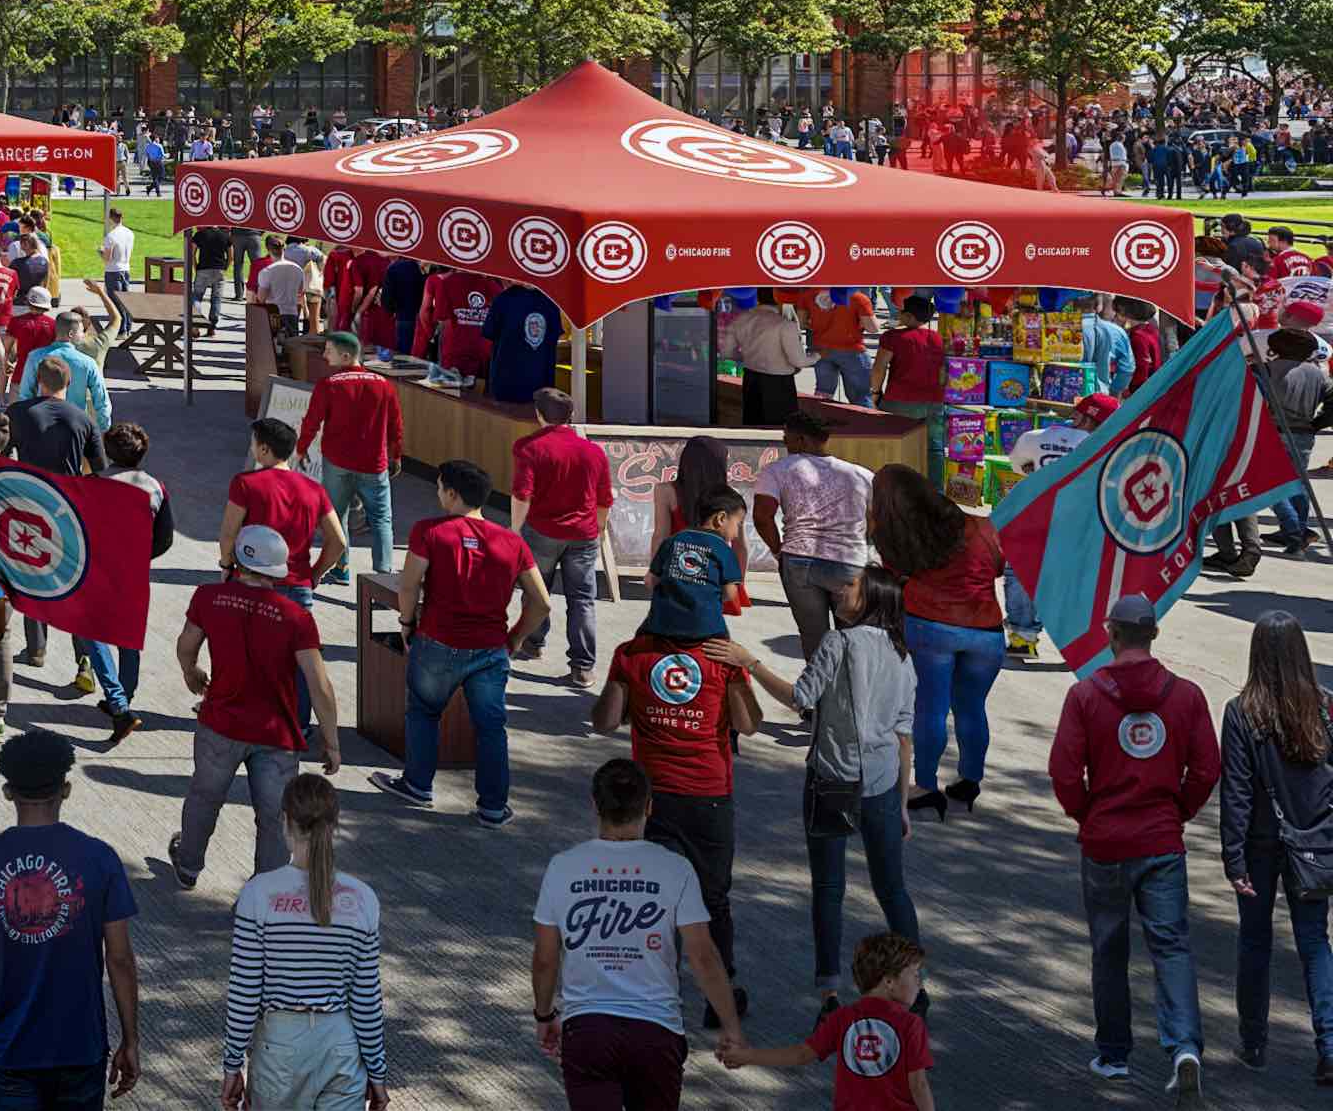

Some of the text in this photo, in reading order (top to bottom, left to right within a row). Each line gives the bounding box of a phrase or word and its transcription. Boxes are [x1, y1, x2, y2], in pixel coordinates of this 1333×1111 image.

[678, 247, 731, 257] CHICAGO FIRE
[862, 247, 916, 257] CHICAGO FIRE
[1037, 247, 1090, 256] CHICAGO FIRE
[645, 706, 705, 720] CHICAGO
[684, 720, 701, 730] FC
[45, 861, 72, 898] FIRE
[570, 879, 661, 895] CHICAGO
[274, 897, 310, 914] FIR
[564, 895, 667, 950] Fire
